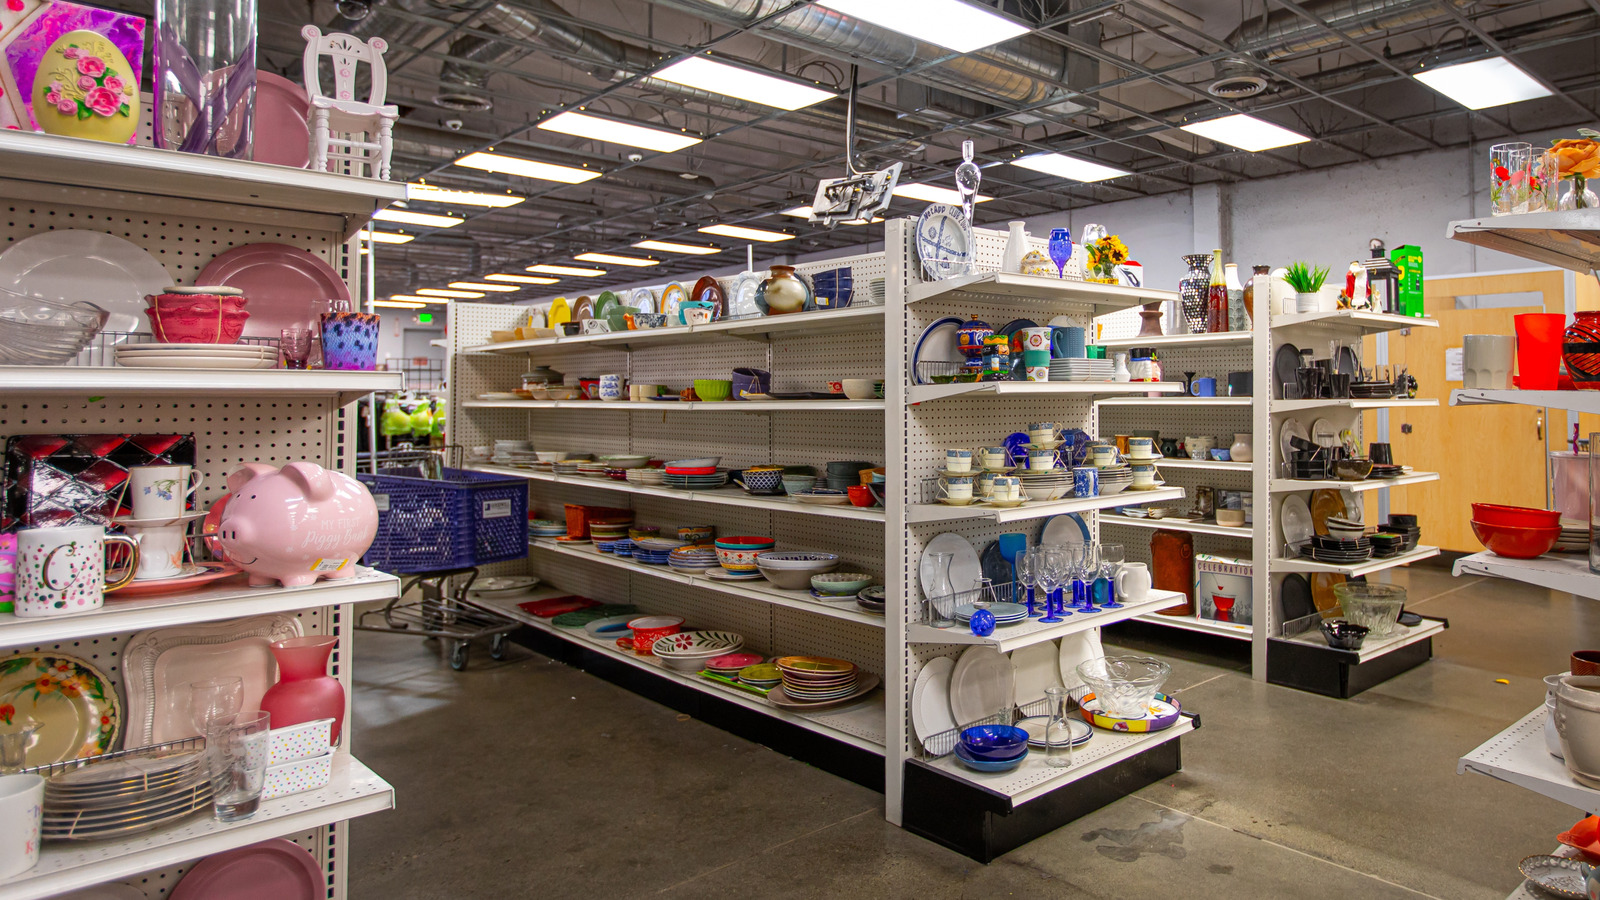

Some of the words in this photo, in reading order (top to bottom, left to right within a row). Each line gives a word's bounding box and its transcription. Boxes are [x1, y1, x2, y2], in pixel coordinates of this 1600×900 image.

[924, 205, 946, 221] NetApp
[321, 519, 334, 530] MY
[338, 517, 360, 530] FIRST
[302, 530, 341, 550] Piggy
[343, 526, 369, 546] Bank
[42, 544, 80, 591] C
[1198, 563, 1253, 576] CELEBRATION
